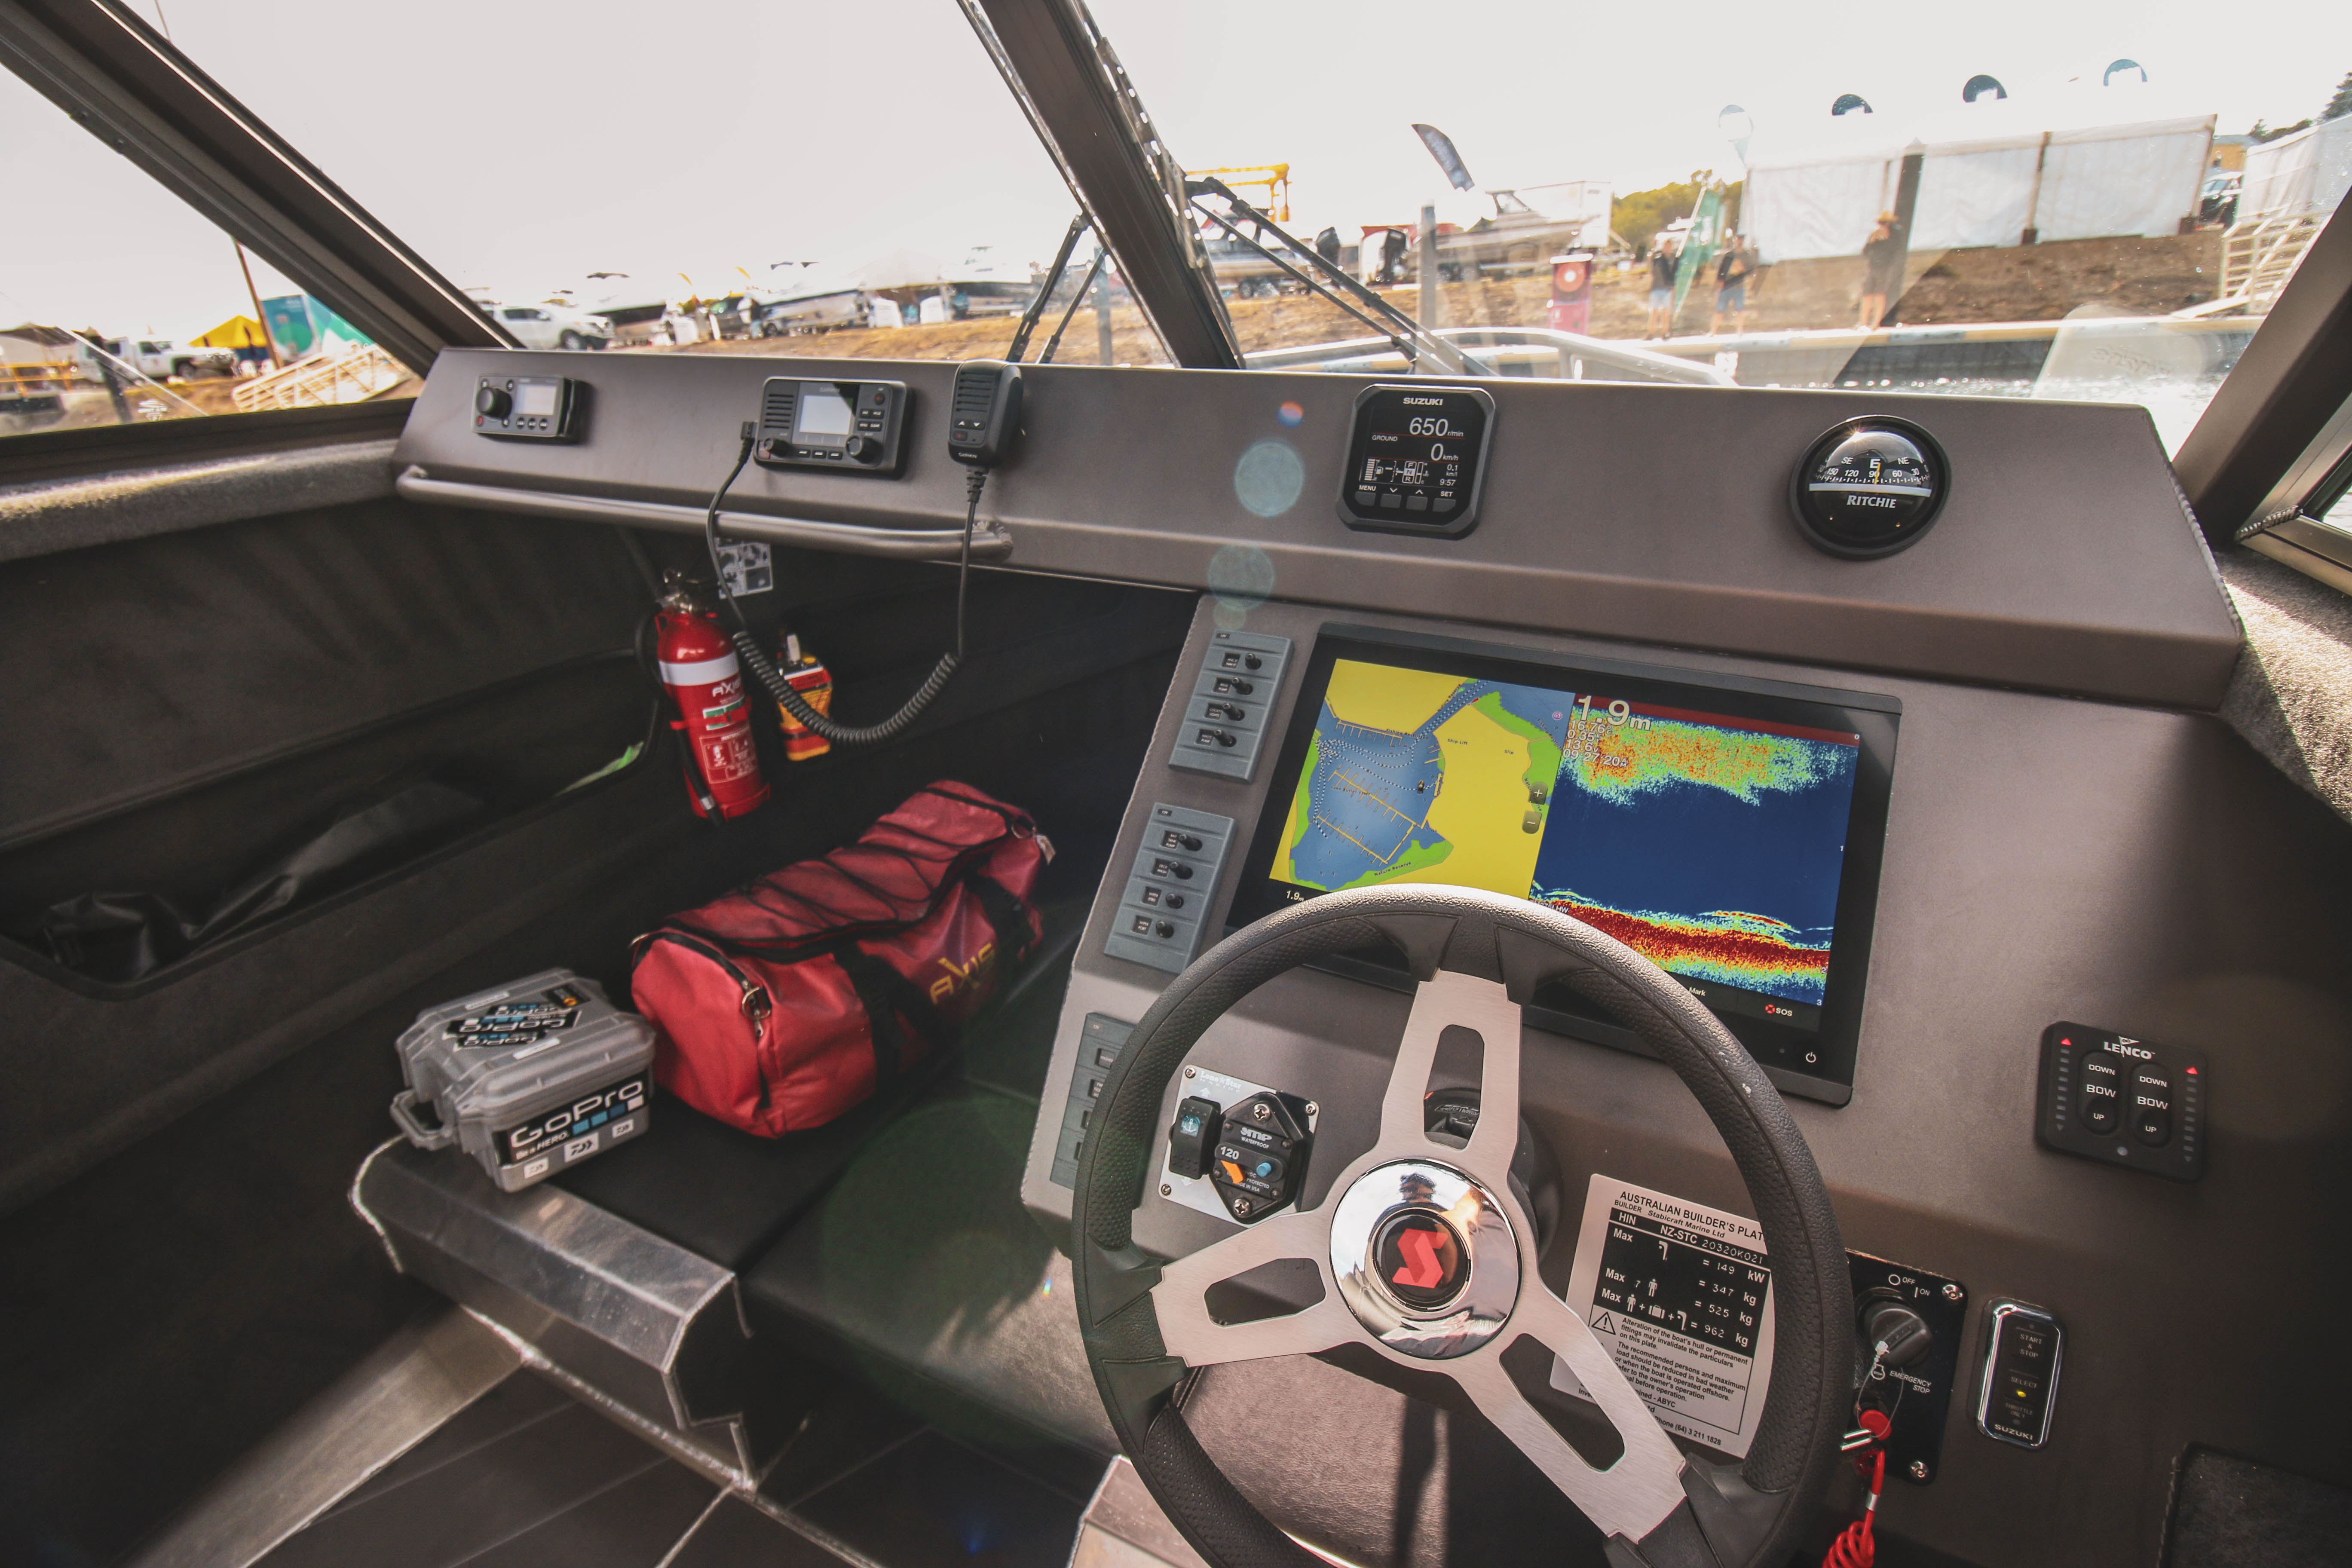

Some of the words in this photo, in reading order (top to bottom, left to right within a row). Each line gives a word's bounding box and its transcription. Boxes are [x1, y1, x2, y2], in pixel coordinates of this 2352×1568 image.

[1403, 397, 1443, 406] SUZUKI
[1409, 417, 1449, 437] 650
[1431, 443, 1443, 461] 0
[1870, 459, 1880, 469] E
[1911, 468, 1920, 476] 30
[1847, 495, 1896, 509] RITCHIE
[1374, 868, 1390, 876] Nature
[1392, 861, 1411, 870] Reserve
[1689, 987, 1706, 996] Mark
[1776, 1008, 1792, 1017] SOS
[459, 1018, 566, 1032] GoPro
[2104, 1041, 2152, 1059] LENCO
[2089, 1064, 2115, 1075] DOWN
[2139, 1076, 2167, 1087] DOWN
[2086, 1084, 2116, 1097] BOW
[2137, 1096, 2168, 1110] BOW
[510, 1081, 643, 1148] GoPro
[1241, 1136, 1269, 1149] WATERPROOF
[1220, 1146, 1239, 1160] 120
[1246, 1178, 1270, 1189] PROTECTED
[1614, 1199, 1642, 1213] BUILDER
[1648, 1210, 1684, 1226] Stabicraft
[1685, 1221, 1710, 1234] Marine
[1712, 1229, 1725, 1238] Ltd
[1620, 1191, 1681, 1216] AUSTRALIAN
[1683, 1210, 1735, 1232] BUILDER'S
[1737, 1226, 1765, 1242] PLAT
[1619, 1212, 1636, 1225] HIN
[1660, 1225, 1698, 1244] NZ-STC
[1702, 1239, 1762, 1265] 20320K021
[1613, 1228, 1634, 1242] Max
[1717, 1262, 1735, 1274] 149
[1748, 1270, 1765, 1283] kW
[1605, 1268, 1626, 1283] Max
[1712, 1283, 1734, 1297] 347
[1743, 1292, 1757, 1306] kg
[1902, 1277, 1916, 1285] OFF
[1602, 1288, 1621, 1303] Max
[1709, 1304, 1729, 1317] 525
[1740, 1311, 1753, 1326] kg
[1622, 1317, 1652, 1332] Alteration
[1672, 1334, 1691, 1345] boat's
[1692, 1341, 1704, 1350] hull
[1714, 1349, 1748, 1365] permanent
[1629, 1334, 1640, 1343] this
[1642, 1340, 1658, 1350] plate.
[1704, 1325, 1724, 1338] 962
[1735, 1332, 1749, 1348] kg
[2020, 1334, 2043, 1345] START
[1621, 1324, 1642, 1337] fittings
[1643, 1332, 1657, 1342] may
[1657, 1337, 1687, 1351] invalidate
[1688, 1348, 1698, 1356] the
[1700, 1352, 1733, 1368] particulars
[2020, 1348, 2039, 1358] STOP
[1616, 1348, 1629, 1357] load
[1631, 1354, 1652, 1365] should
[1662, 1365, 1687, 1378] reduced
[1696, 1377, 1708, 1385] bad
[1709, 1382, 1734, 1395] weather
[1618, 1341, 1629, 1350] The
[1630, 1347, 1674, 1366] recommended
[1675, 1362, 1700, 1375] persons
[1701, 1372, 1713, 1380] and
[1715, 1376, 1746, 1391] maximum
[1623, 1359, 1638, 1369] when
[1651, 1368, 1666, 1378] boat
[1673, 1378, 1701, 1391] operated
[1702, 1387, 1730, 1401] offshore.
[1638, 1372, 1648, 1380] the
[1650, 1377, 1674, 1389] owner's
[1675, 1385, 1705, 1400] operation
[1890, 1370, 1932, 1387] EMERGENCY
[2010, 1376, 2038, 1389] SELECT
[1635, 1378, 1655, 1390] before
[1656, 1387, 1687, 1402] operation.
[1913, 1385, 1930, 1394] STOP
[1657, 1397, 1676, 1408] ABYC
[2005, 1402, 2034, 1416] THROTTLE
[2010, 1410, 2026, 1419] ONLY
[1675, 1424, 1687, 1434] (64)
[1694, 1430, 1705, 1440] 211
[1707, 1435, 1721, 1446] 1828
[1994, 1424, 2034, 1441] SUZUKI
